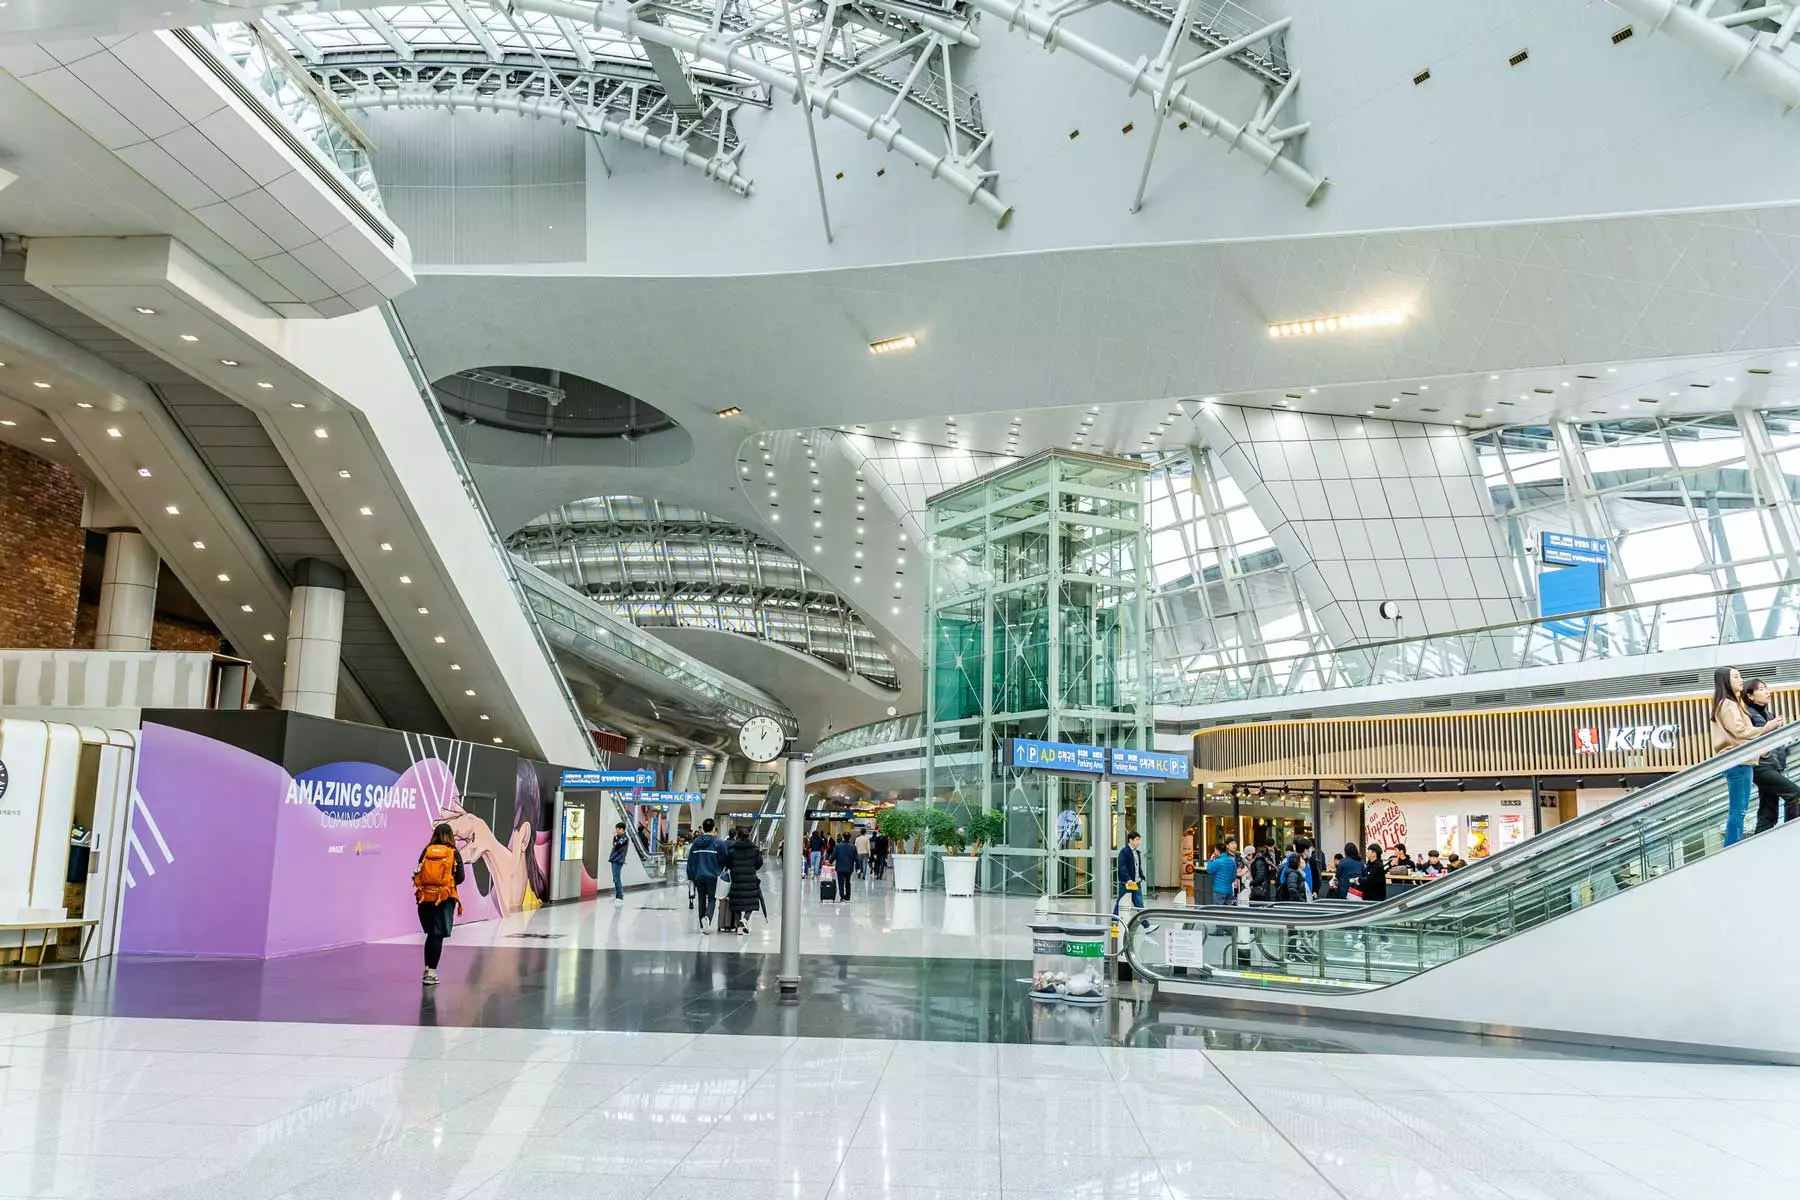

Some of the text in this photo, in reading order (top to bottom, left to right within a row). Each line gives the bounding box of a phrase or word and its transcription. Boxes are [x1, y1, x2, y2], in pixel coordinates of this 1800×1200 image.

[1606, 724, 1678, 751] KFC
[1077, 760, 1093, 770] Parking
[285, 779, 416, 809] AMAZING SQUARE
[321, 811, 388, 829] COMING SOON
[1364, 805, 1401, 842] Appetite
[1369, 812, 1379, 823] an
[1382, 823, 1407, 852] Life
